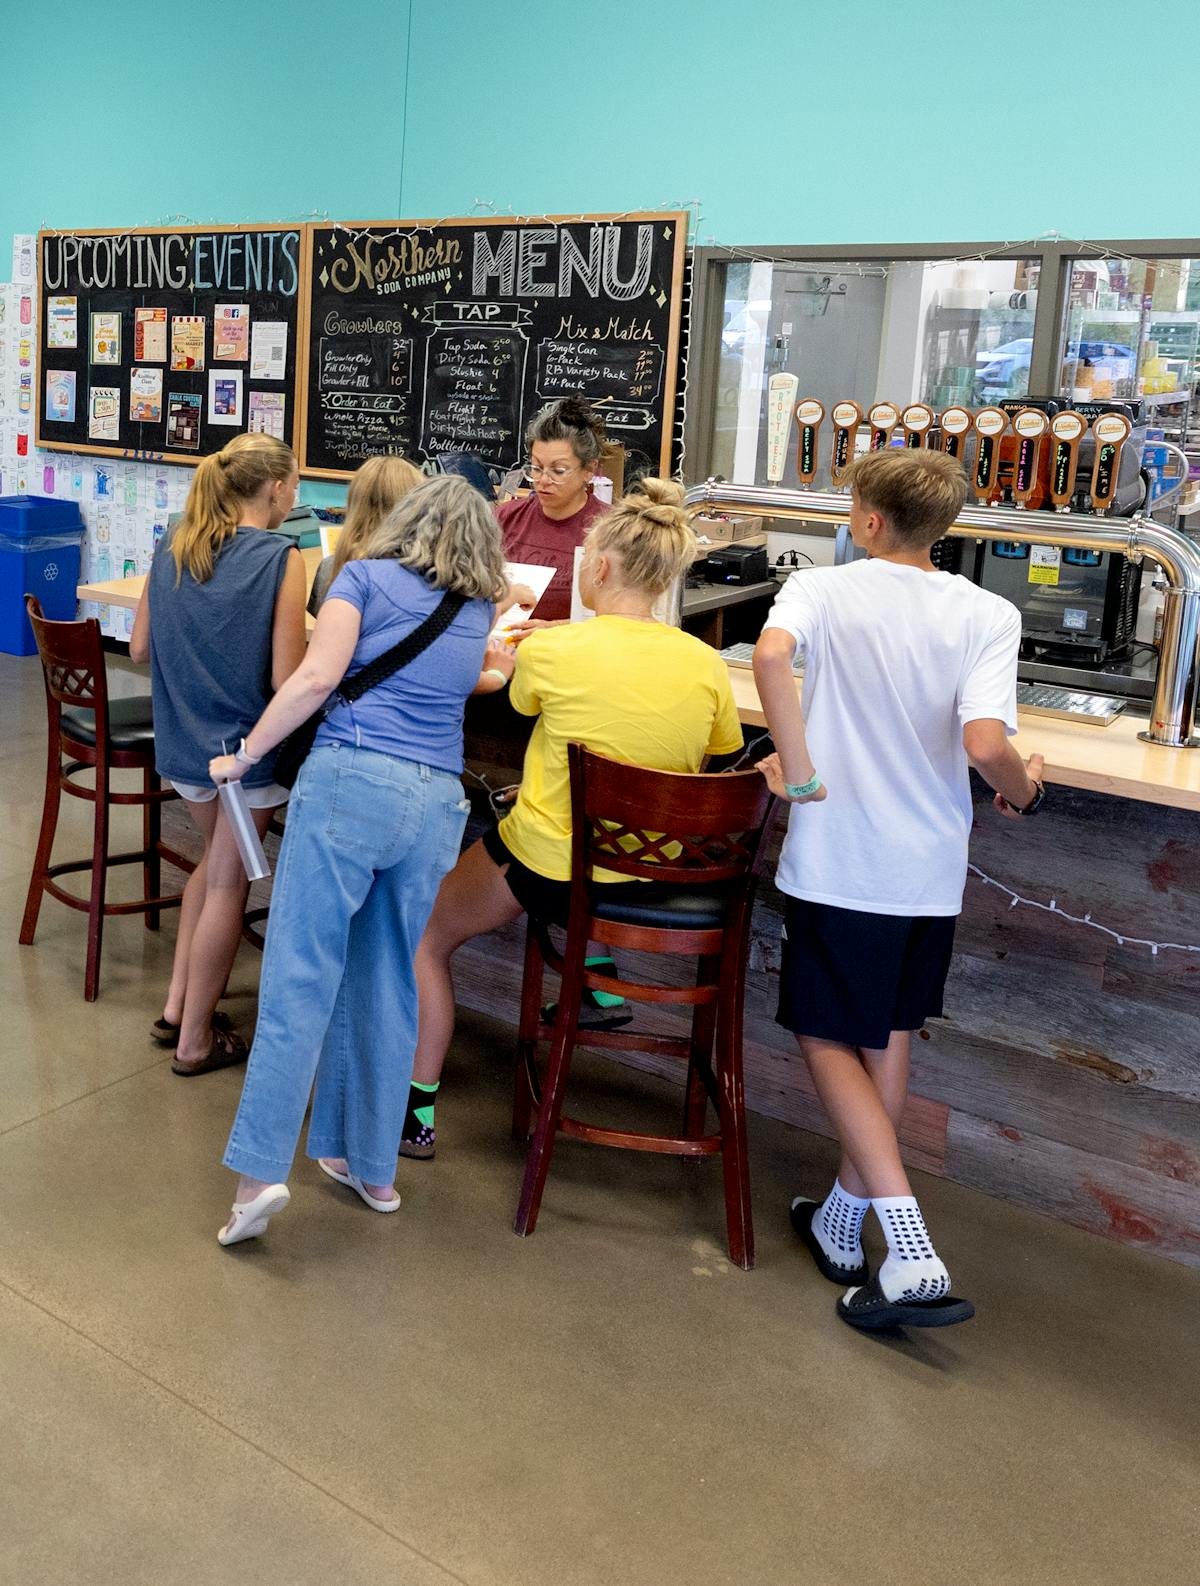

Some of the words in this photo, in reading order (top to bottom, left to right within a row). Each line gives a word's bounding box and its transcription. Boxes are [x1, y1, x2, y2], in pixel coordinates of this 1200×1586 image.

[44, 235, 187, 290] UPCOMING
[194, 232, 299, 296] EVENTS
[331, 234, 463, 294] Northern
[471, 224, 654, 301] MENU
[376, 281, 401, 295] SODA
[405, 267, 451, 289] COMPANY
[452, 303, 501, 320] TAP
[324, 310, 402, 336] Growlers
[554, 314, 588, 340] Mix
[592, 327, 601, 340] &
[600, 316, 655, 341] Match
[443, 337, 460, 354] Tap
[463, 339, 488, 351] Soda
[547, 341, 575, 357] Single
[577, 343, 599, 356] Can
[324, 351, 355, 362] Growler
[355, 354, 373, 366] Only
[439, 352, 466, 367] Dirty
[467, 354, 491, 364] Soda
[324, 363, 338, 372] Fill
[338, 364, 359, 378] Only
[449, 366, 484, 378] Slushie
[491, 369, 499, 380] 4
[545, 364, 563, 375] RB
[566, 366, 601, 381] Variety
[602, 367, 629, 381] Pack
[455, 379, 483, 391] Float
[489, 383, 497, 393] 6
[331, 394, 358, 407] Order
[373, 396, 394, 409] Eat
[447, 402, 475, 416] Flight
[480, 405, 488, 415] 7
[324, 412, 355, 422] Whole
[357, 413, 385, 424] Pizza
[429, 410, 451, 420] Float
[452, 413, 477, 426] Flight
[605, 411, 628, 423] Eat
[429, 421, 456, 438] Dirty
[456, 423, 477, 437] Soda
[325, 440, 359, 452] Jumbo
[428, 437, 463, 452] Bottled
